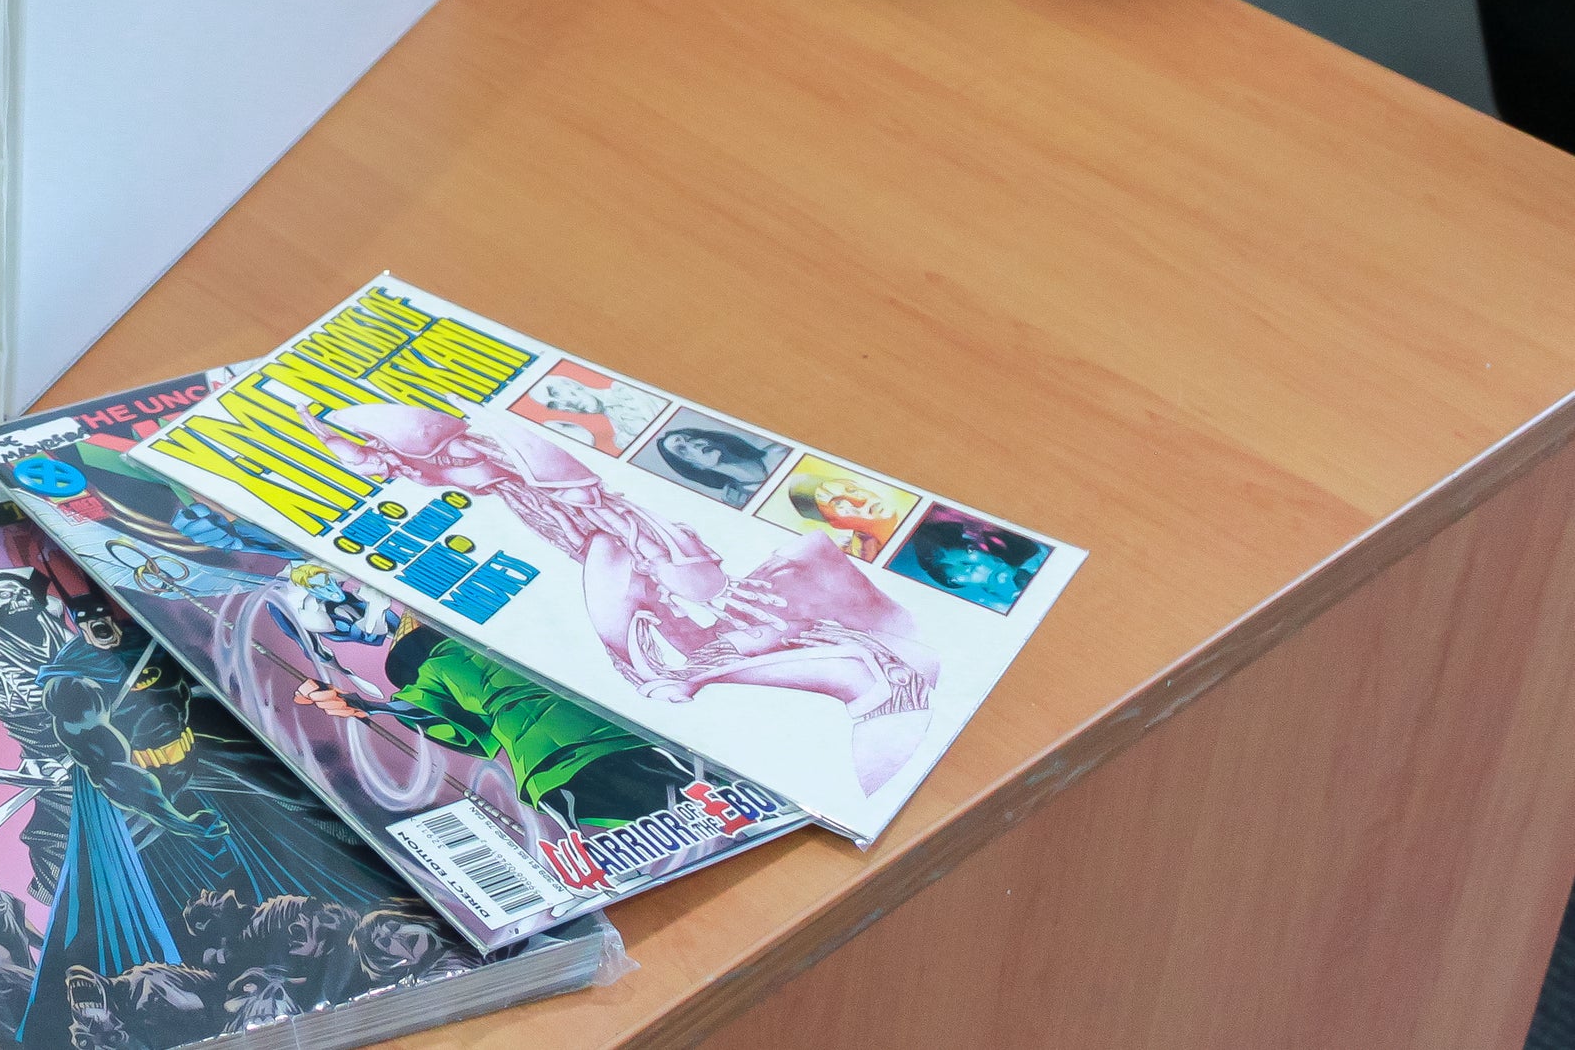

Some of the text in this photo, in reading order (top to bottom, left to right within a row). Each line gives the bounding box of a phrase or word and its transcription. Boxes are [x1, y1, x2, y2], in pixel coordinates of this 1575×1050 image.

[292, 306, 410, 379] BOOKS
[357, 287, 435, 331] OF
[366, 317, 537, 418] ASKANI
[396, 830, 490, 918] DIRECT EDITION
[538, 811, 700, 889] WARRIOR
[677, 803, 699, 820] OF
[691, 817, 722, 838] THE
